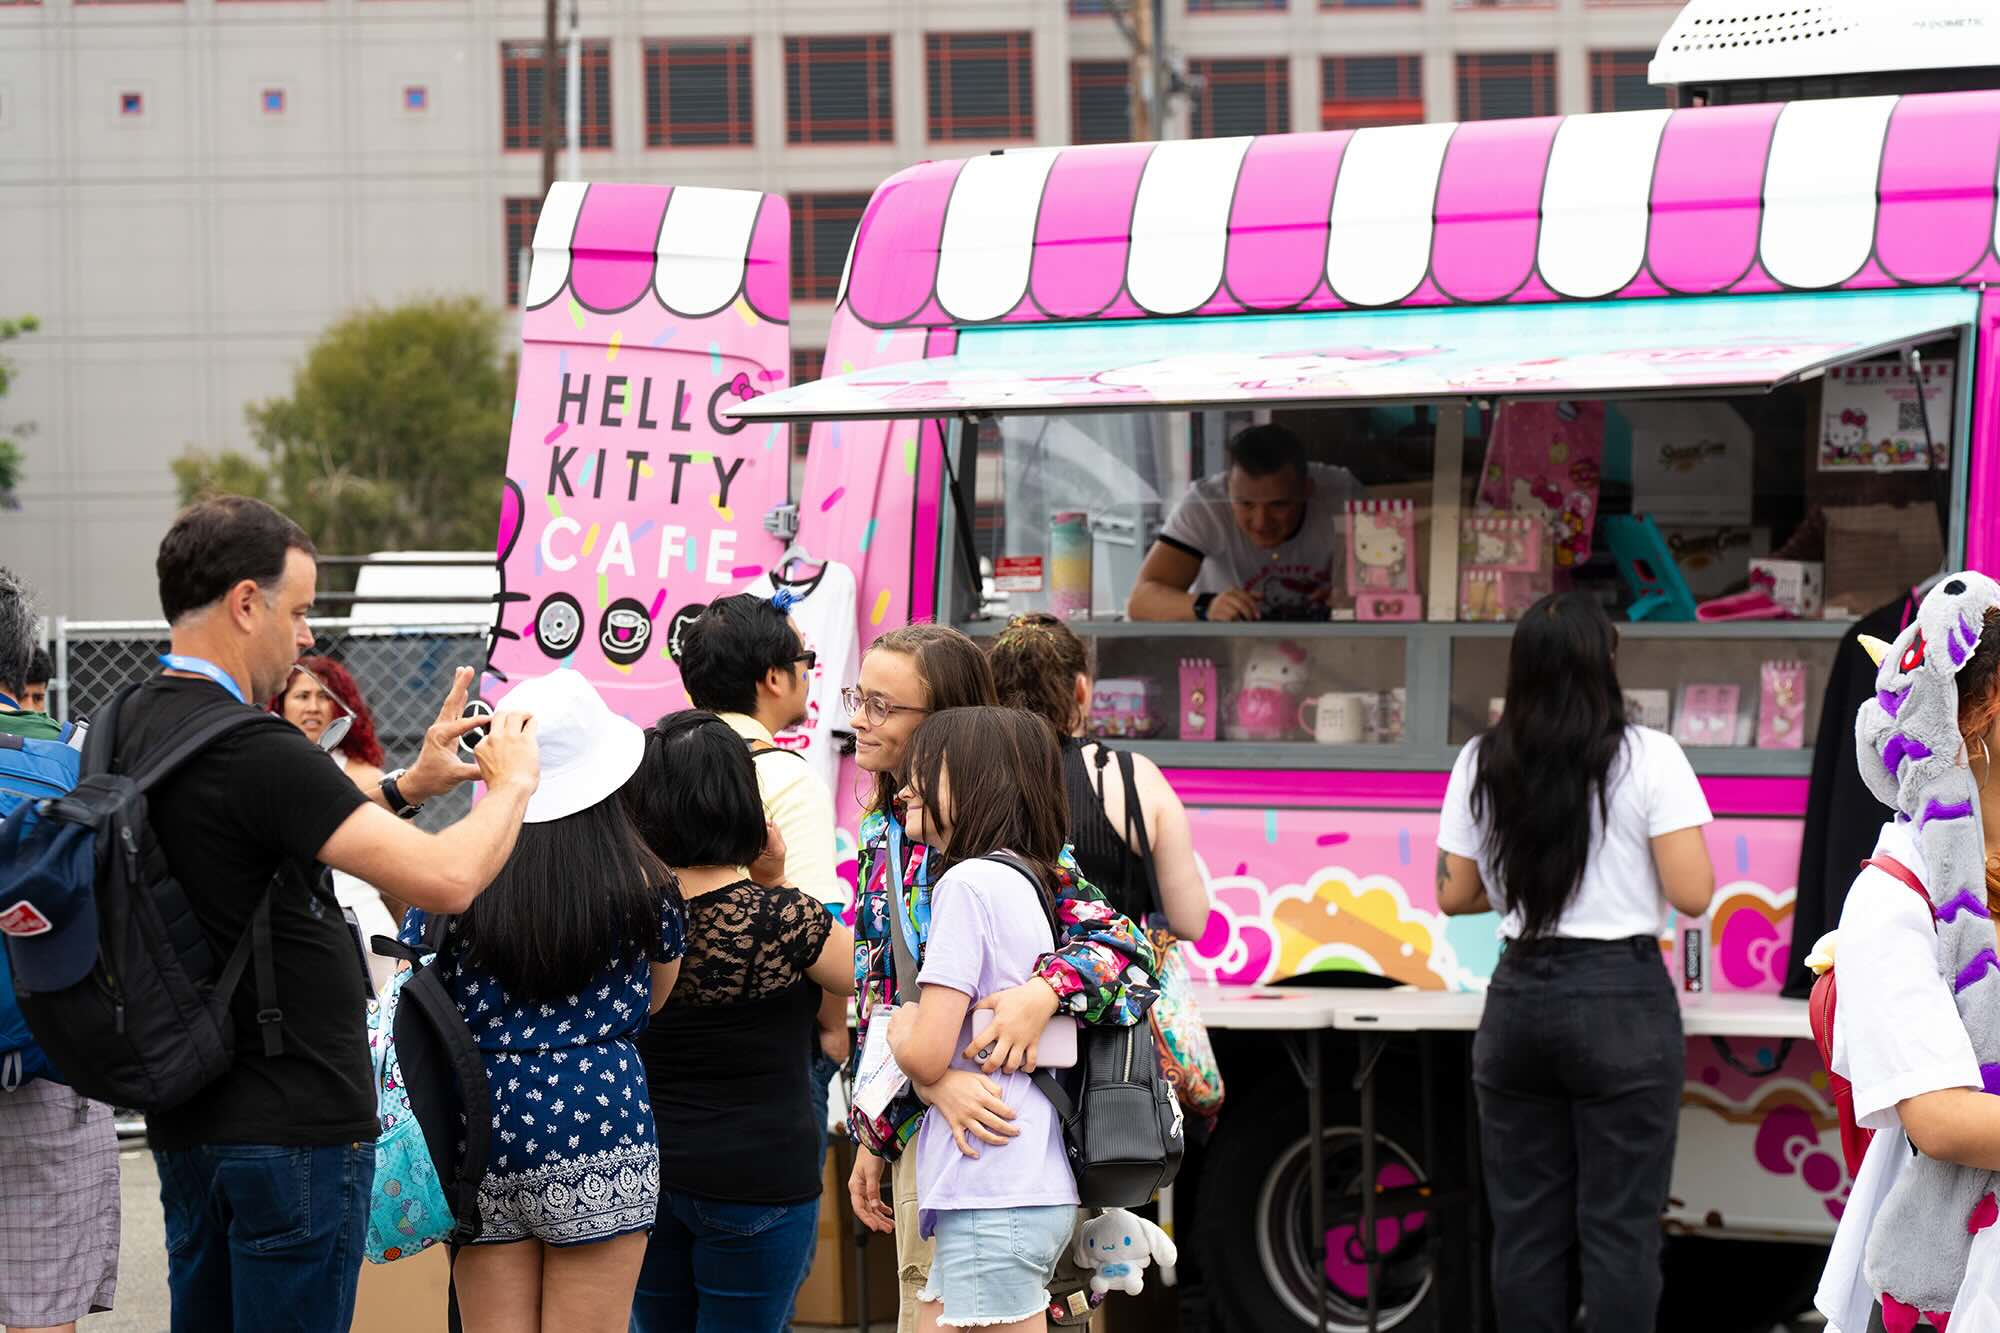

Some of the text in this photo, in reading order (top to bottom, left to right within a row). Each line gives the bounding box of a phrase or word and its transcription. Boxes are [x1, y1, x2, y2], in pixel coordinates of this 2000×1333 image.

[556, 372, 748, 435] HELLO
[547, 446, 745, 508] KITTY
[540, 517, 737, 584] CAFE
